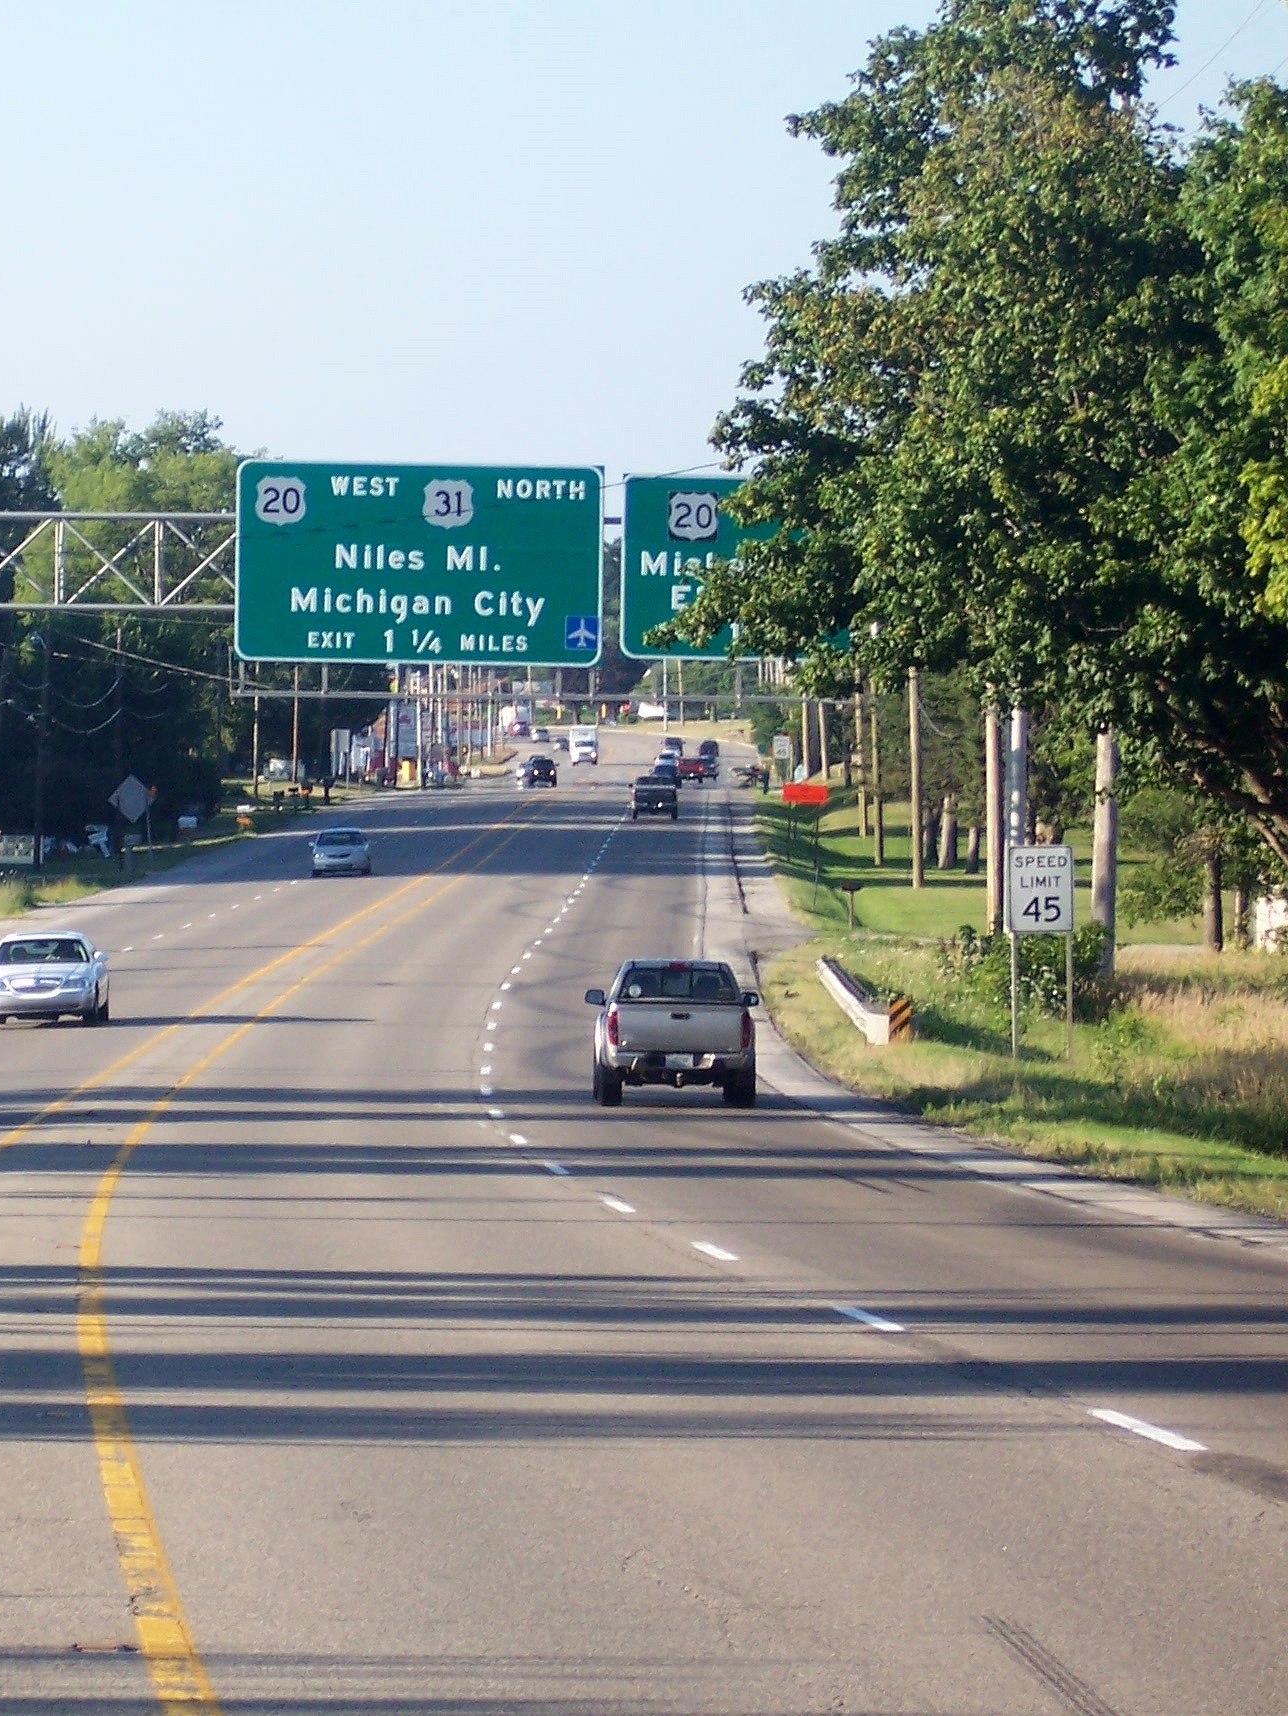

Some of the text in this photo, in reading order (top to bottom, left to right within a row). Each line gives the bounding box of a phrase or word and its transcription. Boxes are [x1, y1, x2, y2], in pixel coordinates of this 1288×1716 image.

[263, 475, 585, 517] 20 WEST 31 NORTH
[673, 503, 713, 529] 20
[335, 543, 501, 571] Niles MI.
[290, 587, 545, 627] Michigan City
[307, 631, 355, 649] EXIT
[383, 629, 394, 652] 1
[460, 634, 528, 652] MILES
[1014, 855, 1068, 868] SPEED
[1020, 875, 1061, 888] LIMIT
[1022, 896, 1061, 922] 45
